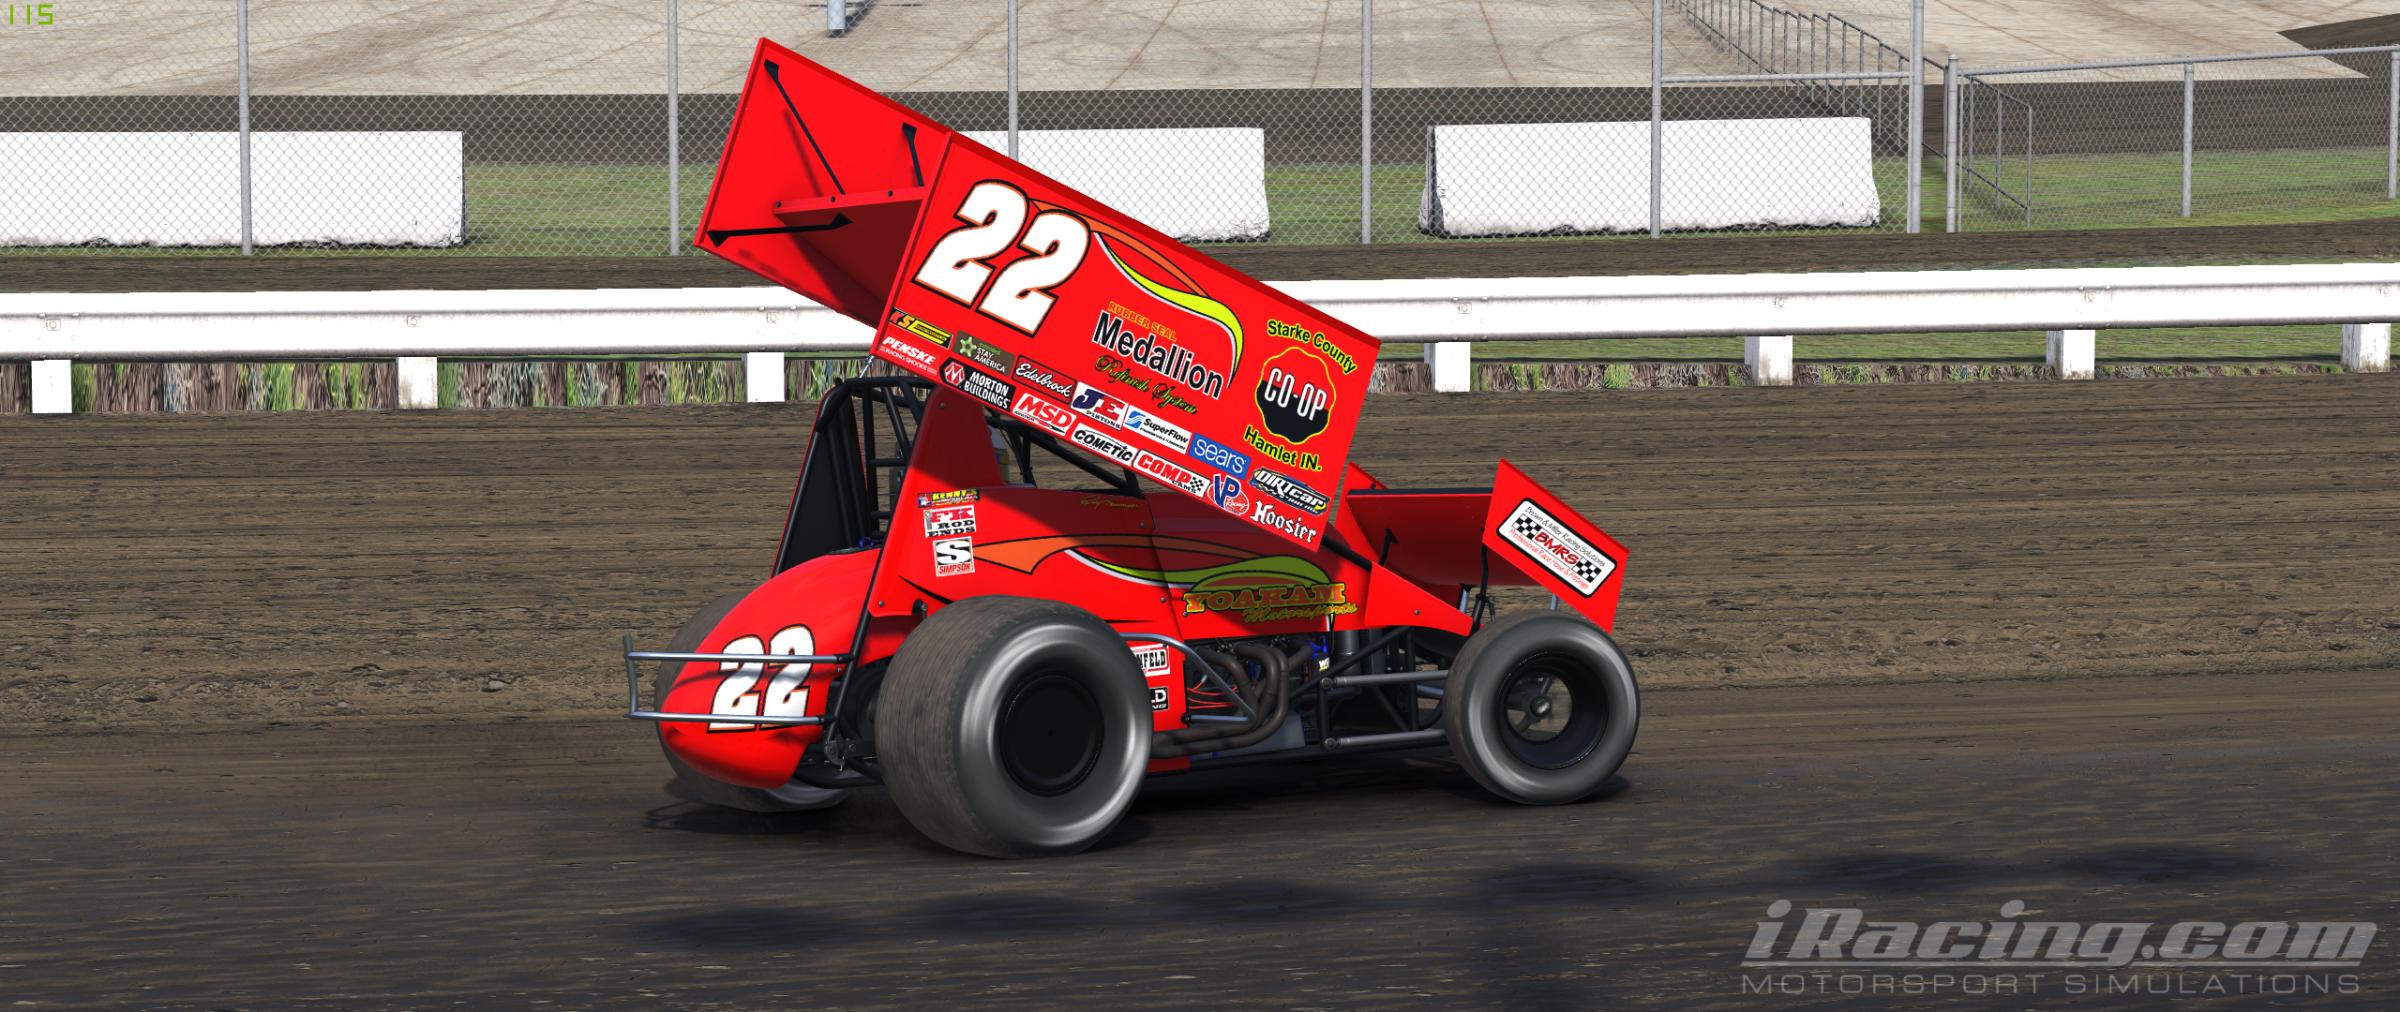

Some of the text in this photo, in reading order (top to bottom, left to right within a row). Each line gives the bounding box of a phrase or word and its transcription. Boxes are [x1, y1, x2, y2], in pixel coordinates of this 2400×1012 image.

[911, 179, 1092, 339] 22
[1107, 301, 1177, 342] RUBBER SEAL
[882, 336, 937, 366] PENSKE
[976, 347, 994, 359] STAY
[1092, 310, 1224, 400] Medallion
[1267, 319, 1358, 375] Starke County
[974, 355, 1006, 374] AMERICA
[1015, 363, 1073, 398] Edelbrock
[963, 381, 1011, 409] BUILDINGS
[969, 371, 1009, 397] MORTON
[1264, 367, 1328, 421] CO-OP
[1018, 396, 1073, 428] MSD
[1071, 388, 1125, 422] JE
[1086, 409, 1121, 429] PISTONS
[1143, 418, 1189, 444] SuperFlow
[1194, 439, 1247, 474] sears
[1243, 424, 1323, 472] Hamlet IN.
[1137, 454, 1192, 484] COMP
[1171, 479, 1197, 494] CAMS
[1213, 473, 1242, 509] VP
[927, 527, 975, 537] ENDS
[938, 520, 975, 530] ROD
[1250, 500, 1317, 543] Hoosier
[1534, 531, 1580, 565] BMRS
[939, 563, 971, 574] SIMPSON
[1183, 582, 1346, 614] YOAKAM
[706, 623, 816, 734] 22
